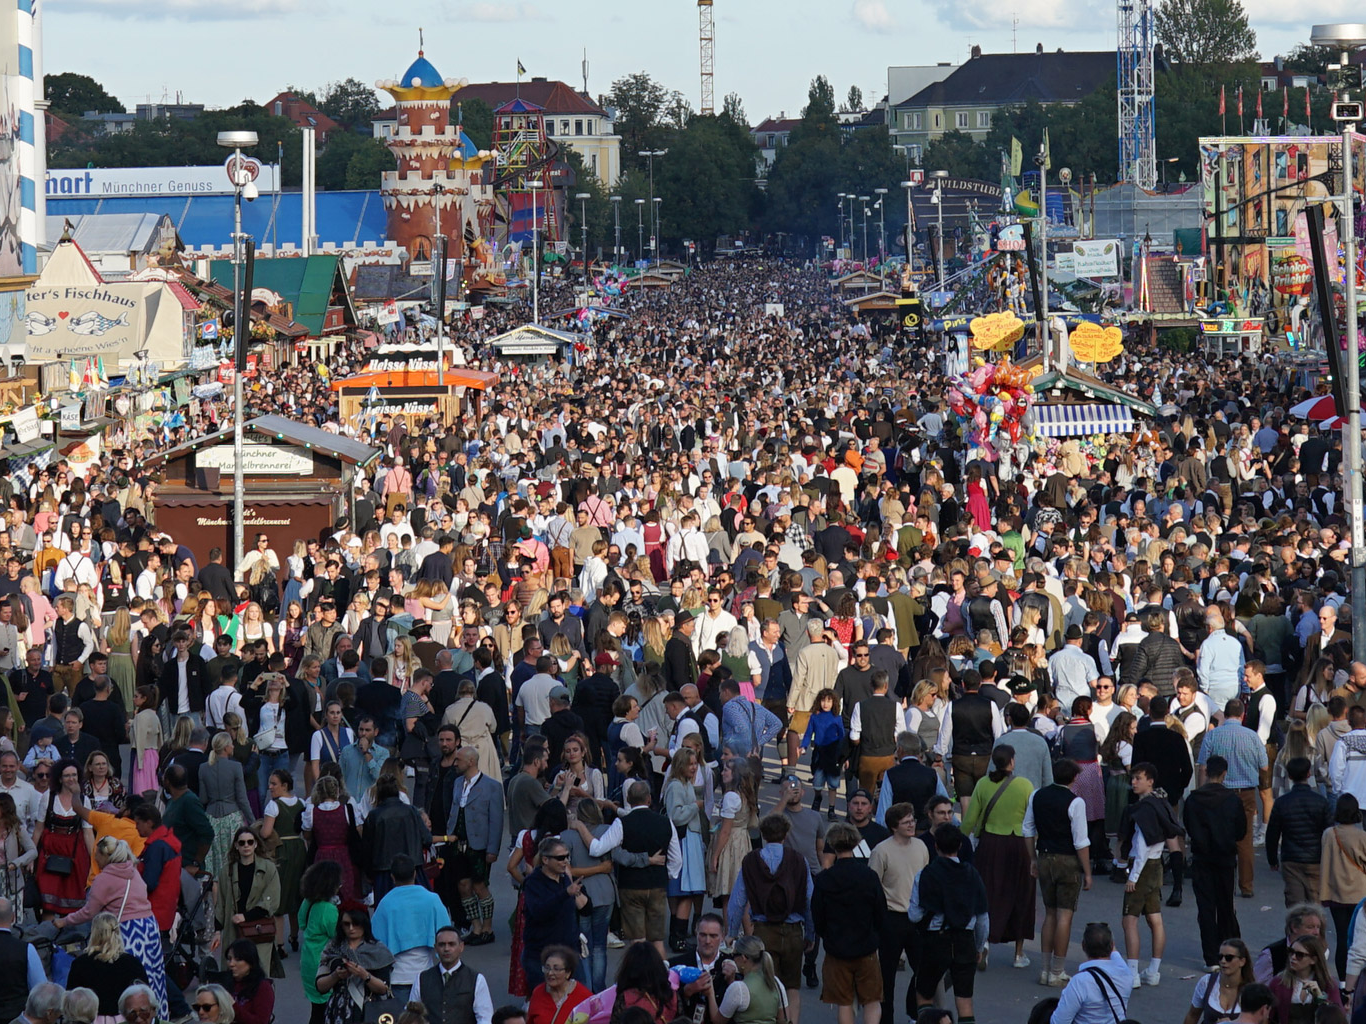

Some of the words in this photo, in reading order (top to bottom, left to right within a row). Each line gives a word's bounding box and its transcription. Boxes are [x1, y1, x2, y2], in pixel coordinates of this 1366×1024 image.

[102, 180, 164, 194] Münchner
[168, 180, 213, 192] Genuss
[65, 286, 137, 309] Fischhaus
[943, 318, 967, 330] Pins
[62, 412, 79, 421] KÄSE
[219, 461, 292, 470] Manelbrennerei
[234, 517, 291, 527] andelbrennerei
